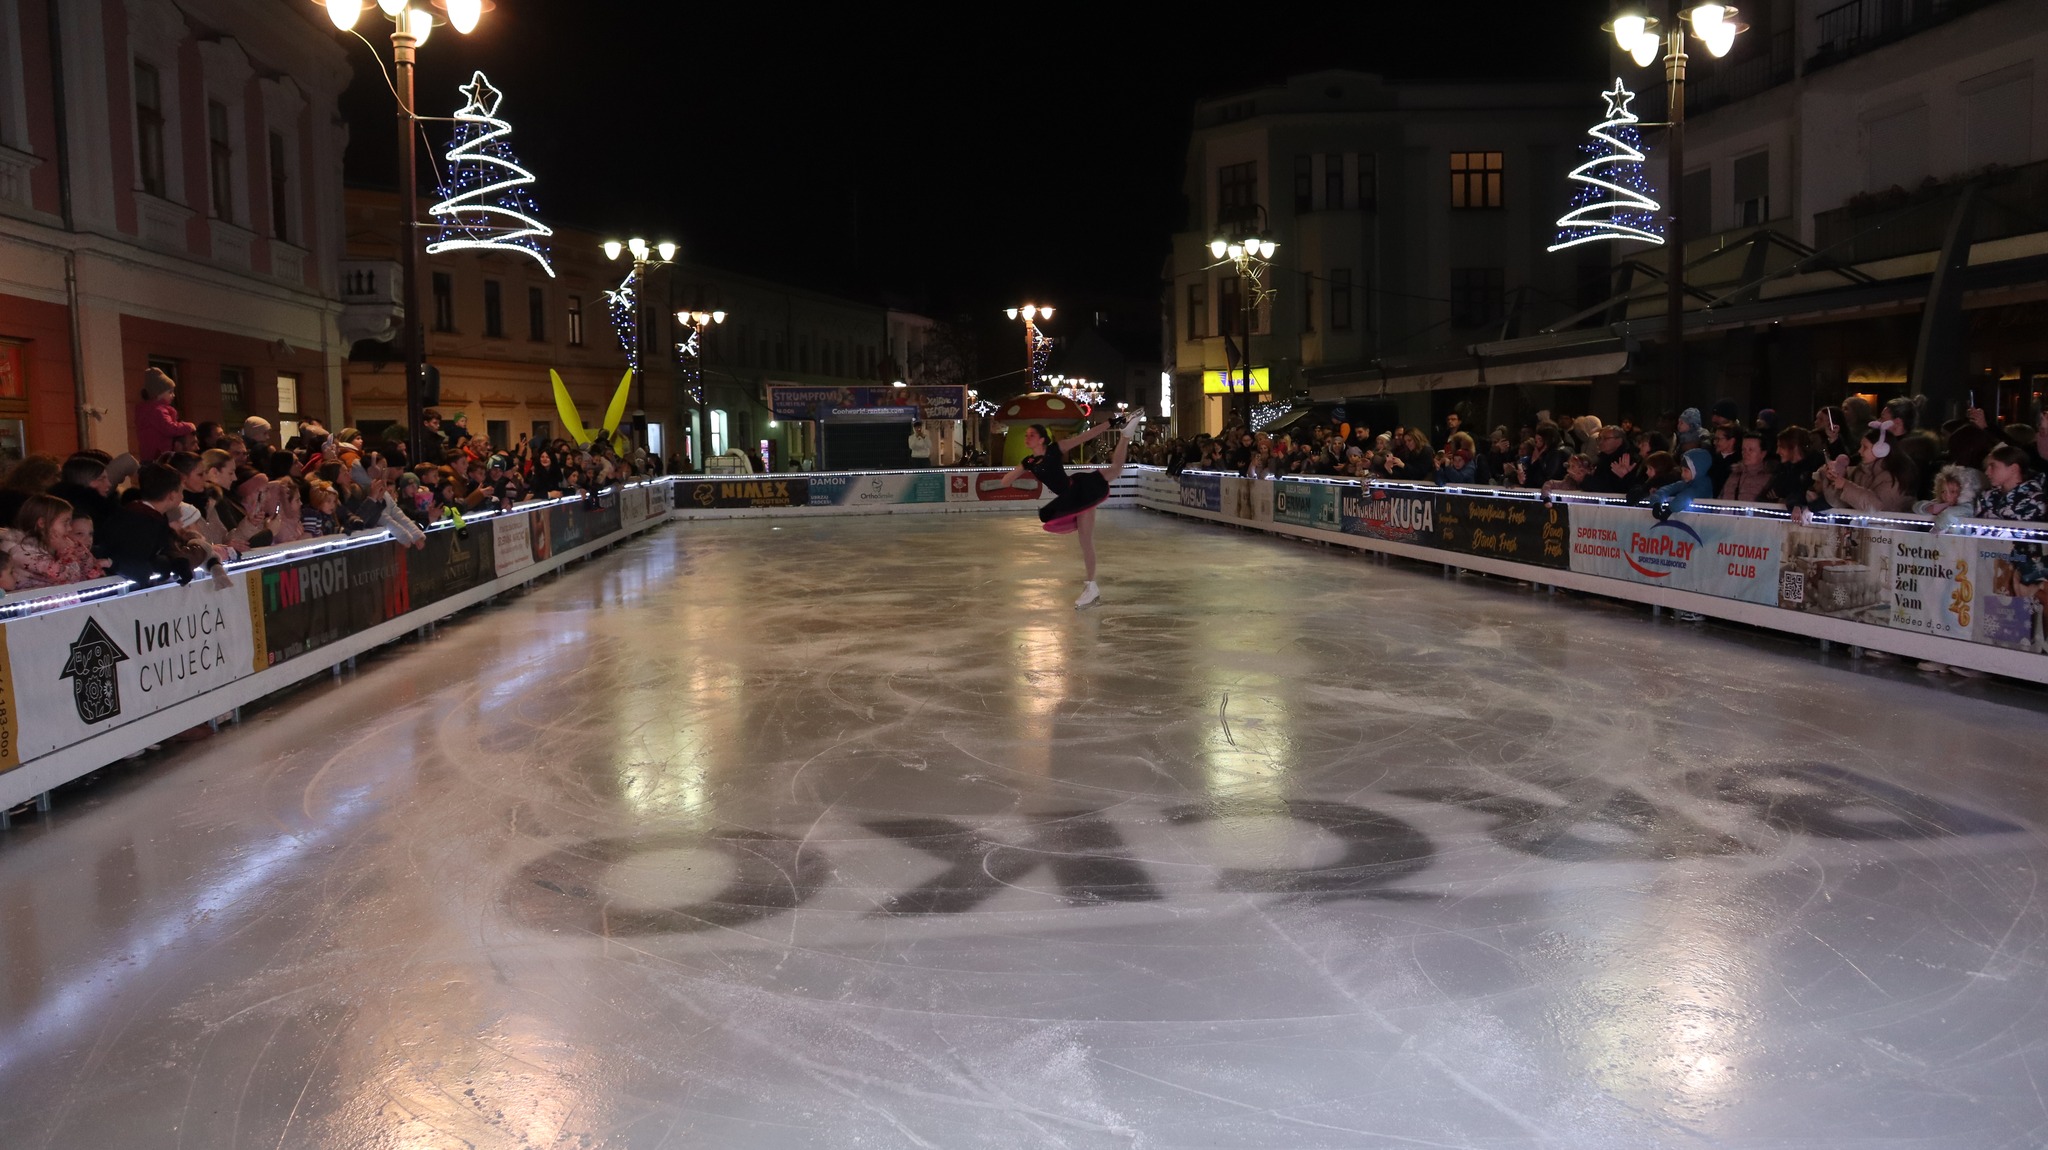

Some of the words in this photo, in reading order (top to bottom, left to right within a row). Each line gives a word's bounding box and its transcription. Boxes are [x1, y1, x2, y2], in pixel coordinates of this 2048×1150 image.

[721, 480, 790, 499] NIMEX
[810, 477, 846, 486] DAMON
[1390, 497, 1434, 533] KUGA
[1577, 527, 1618, 543] SPORTSKA
[1864, 535, 1893, 545] modea
[1573, 543, 1621, 559] KLADIONICA
[1717, 542, 1769, 561] AUTOMAT
[1896, 543, 1940, 561] Sretne
[1727, 563, 1756, 579] CLUB
[1896, 562, 1954, 580] praznike
[1895, 577, 1918, 593] želi
[1894, 592, 1922, 610] Vam
[139, 640, 226, 693] CVIJEĆA
